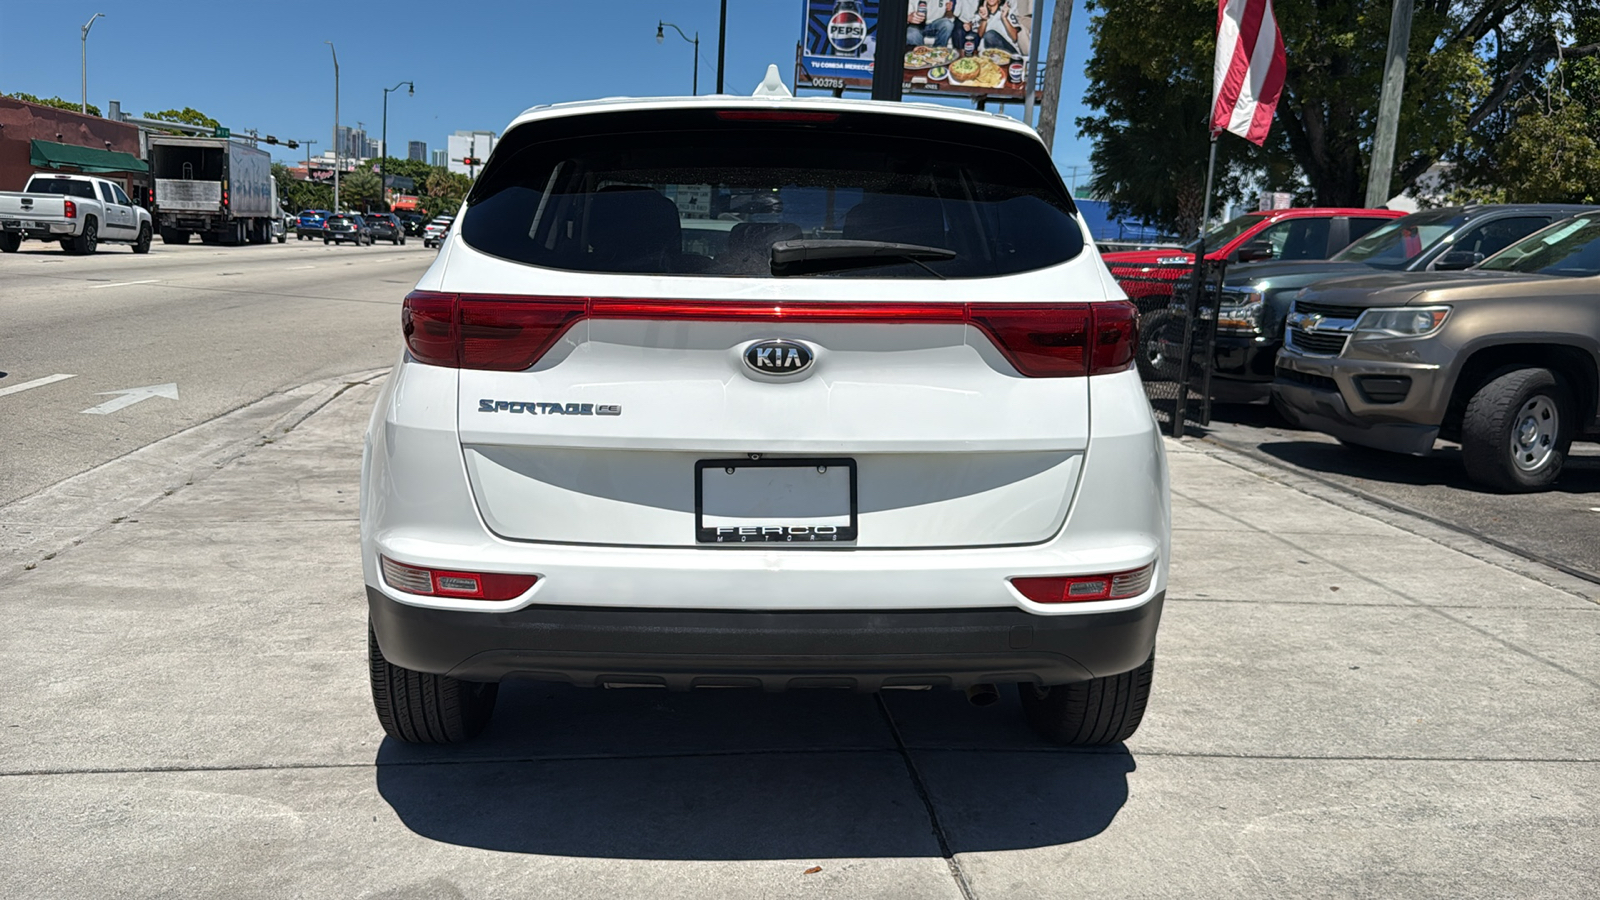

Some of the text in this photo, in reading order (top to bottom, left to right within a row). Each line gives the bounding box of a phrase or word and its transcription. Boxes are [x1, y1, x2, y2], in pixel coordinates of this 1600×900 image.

[830, 25, 864, 36] PEPSI
[812, 77, 843, 88] 003785
[756, 347, 802, 367] KIA
[478, 399, 594, 415] SPORTAGE
[716, 526, 837, 536] FERCO
